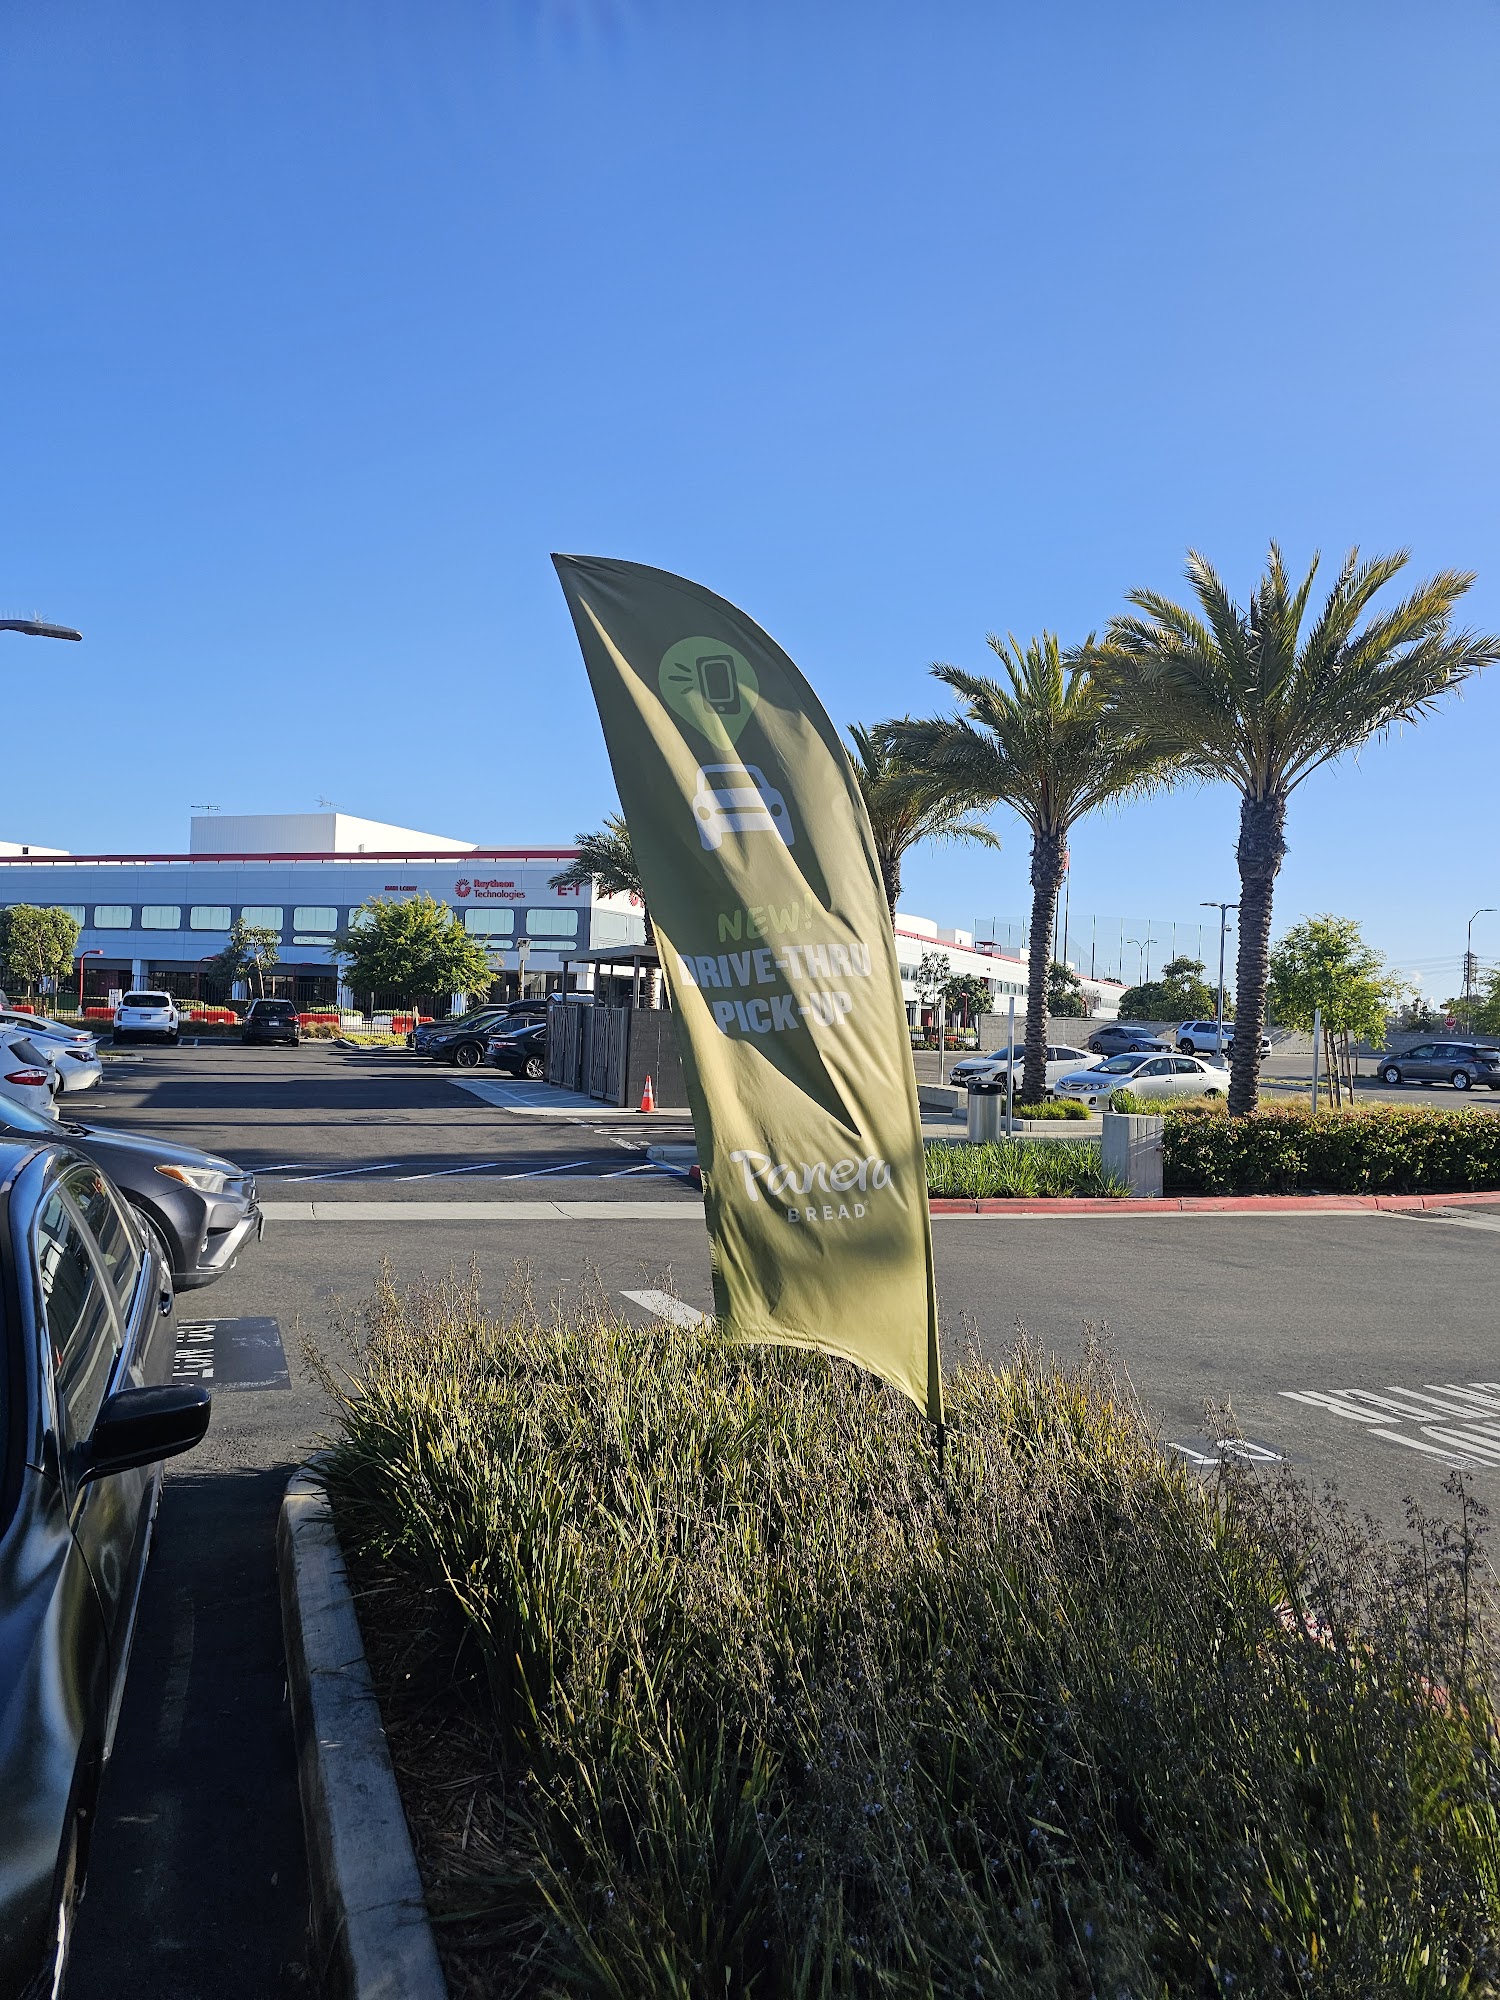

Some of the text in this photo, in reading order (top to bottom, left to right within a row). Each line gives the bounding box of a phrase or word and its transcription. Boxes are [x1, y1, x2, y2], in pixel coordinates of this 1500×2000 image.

[474, 879, 515, 890] Raytheon
[474, 890, 525, 900] Technologies
[718, 893, 812, 942] NEW!
[676, 943, 872, 987] DRIVE-THRU
[711, 991, 853, 1034] PICK-UP
[729, 1150, 895, 1201] Panera
[787, 1203, 867, 1223] BREAD
